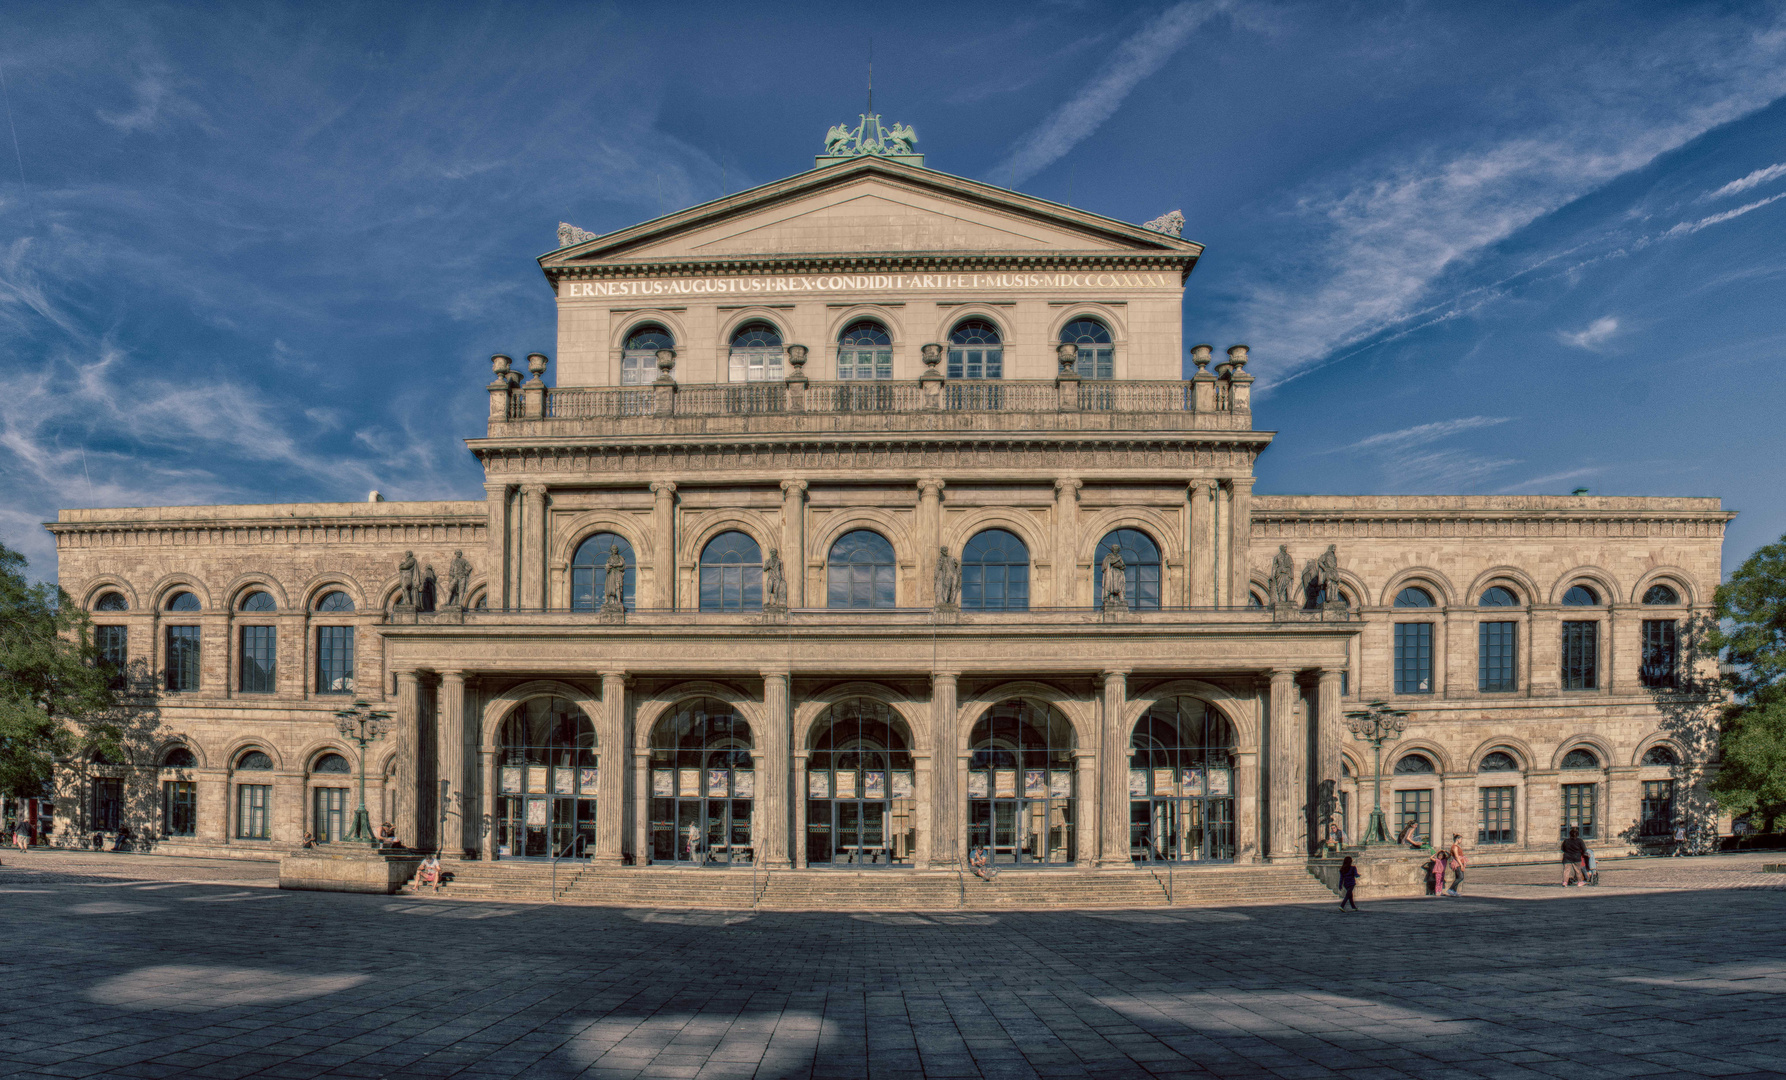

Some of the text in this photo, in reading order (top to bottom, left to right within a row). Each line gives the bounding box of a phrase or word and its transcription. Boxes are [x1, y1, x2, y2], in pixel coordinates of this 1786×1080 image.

[570, 281, 663, 297] ERNESTUS
[667, 278, 761, 294] AUGUSTUS
[765, 278, 771, 291] I
[775, 276, 812, 291] REX
[816, 275, 907, 290] CONDIDIT
[910, 274, 953, 288] ARTI
[957, 274, 982, 288] ET
[986, 274, 1039, 287] MUSIS
